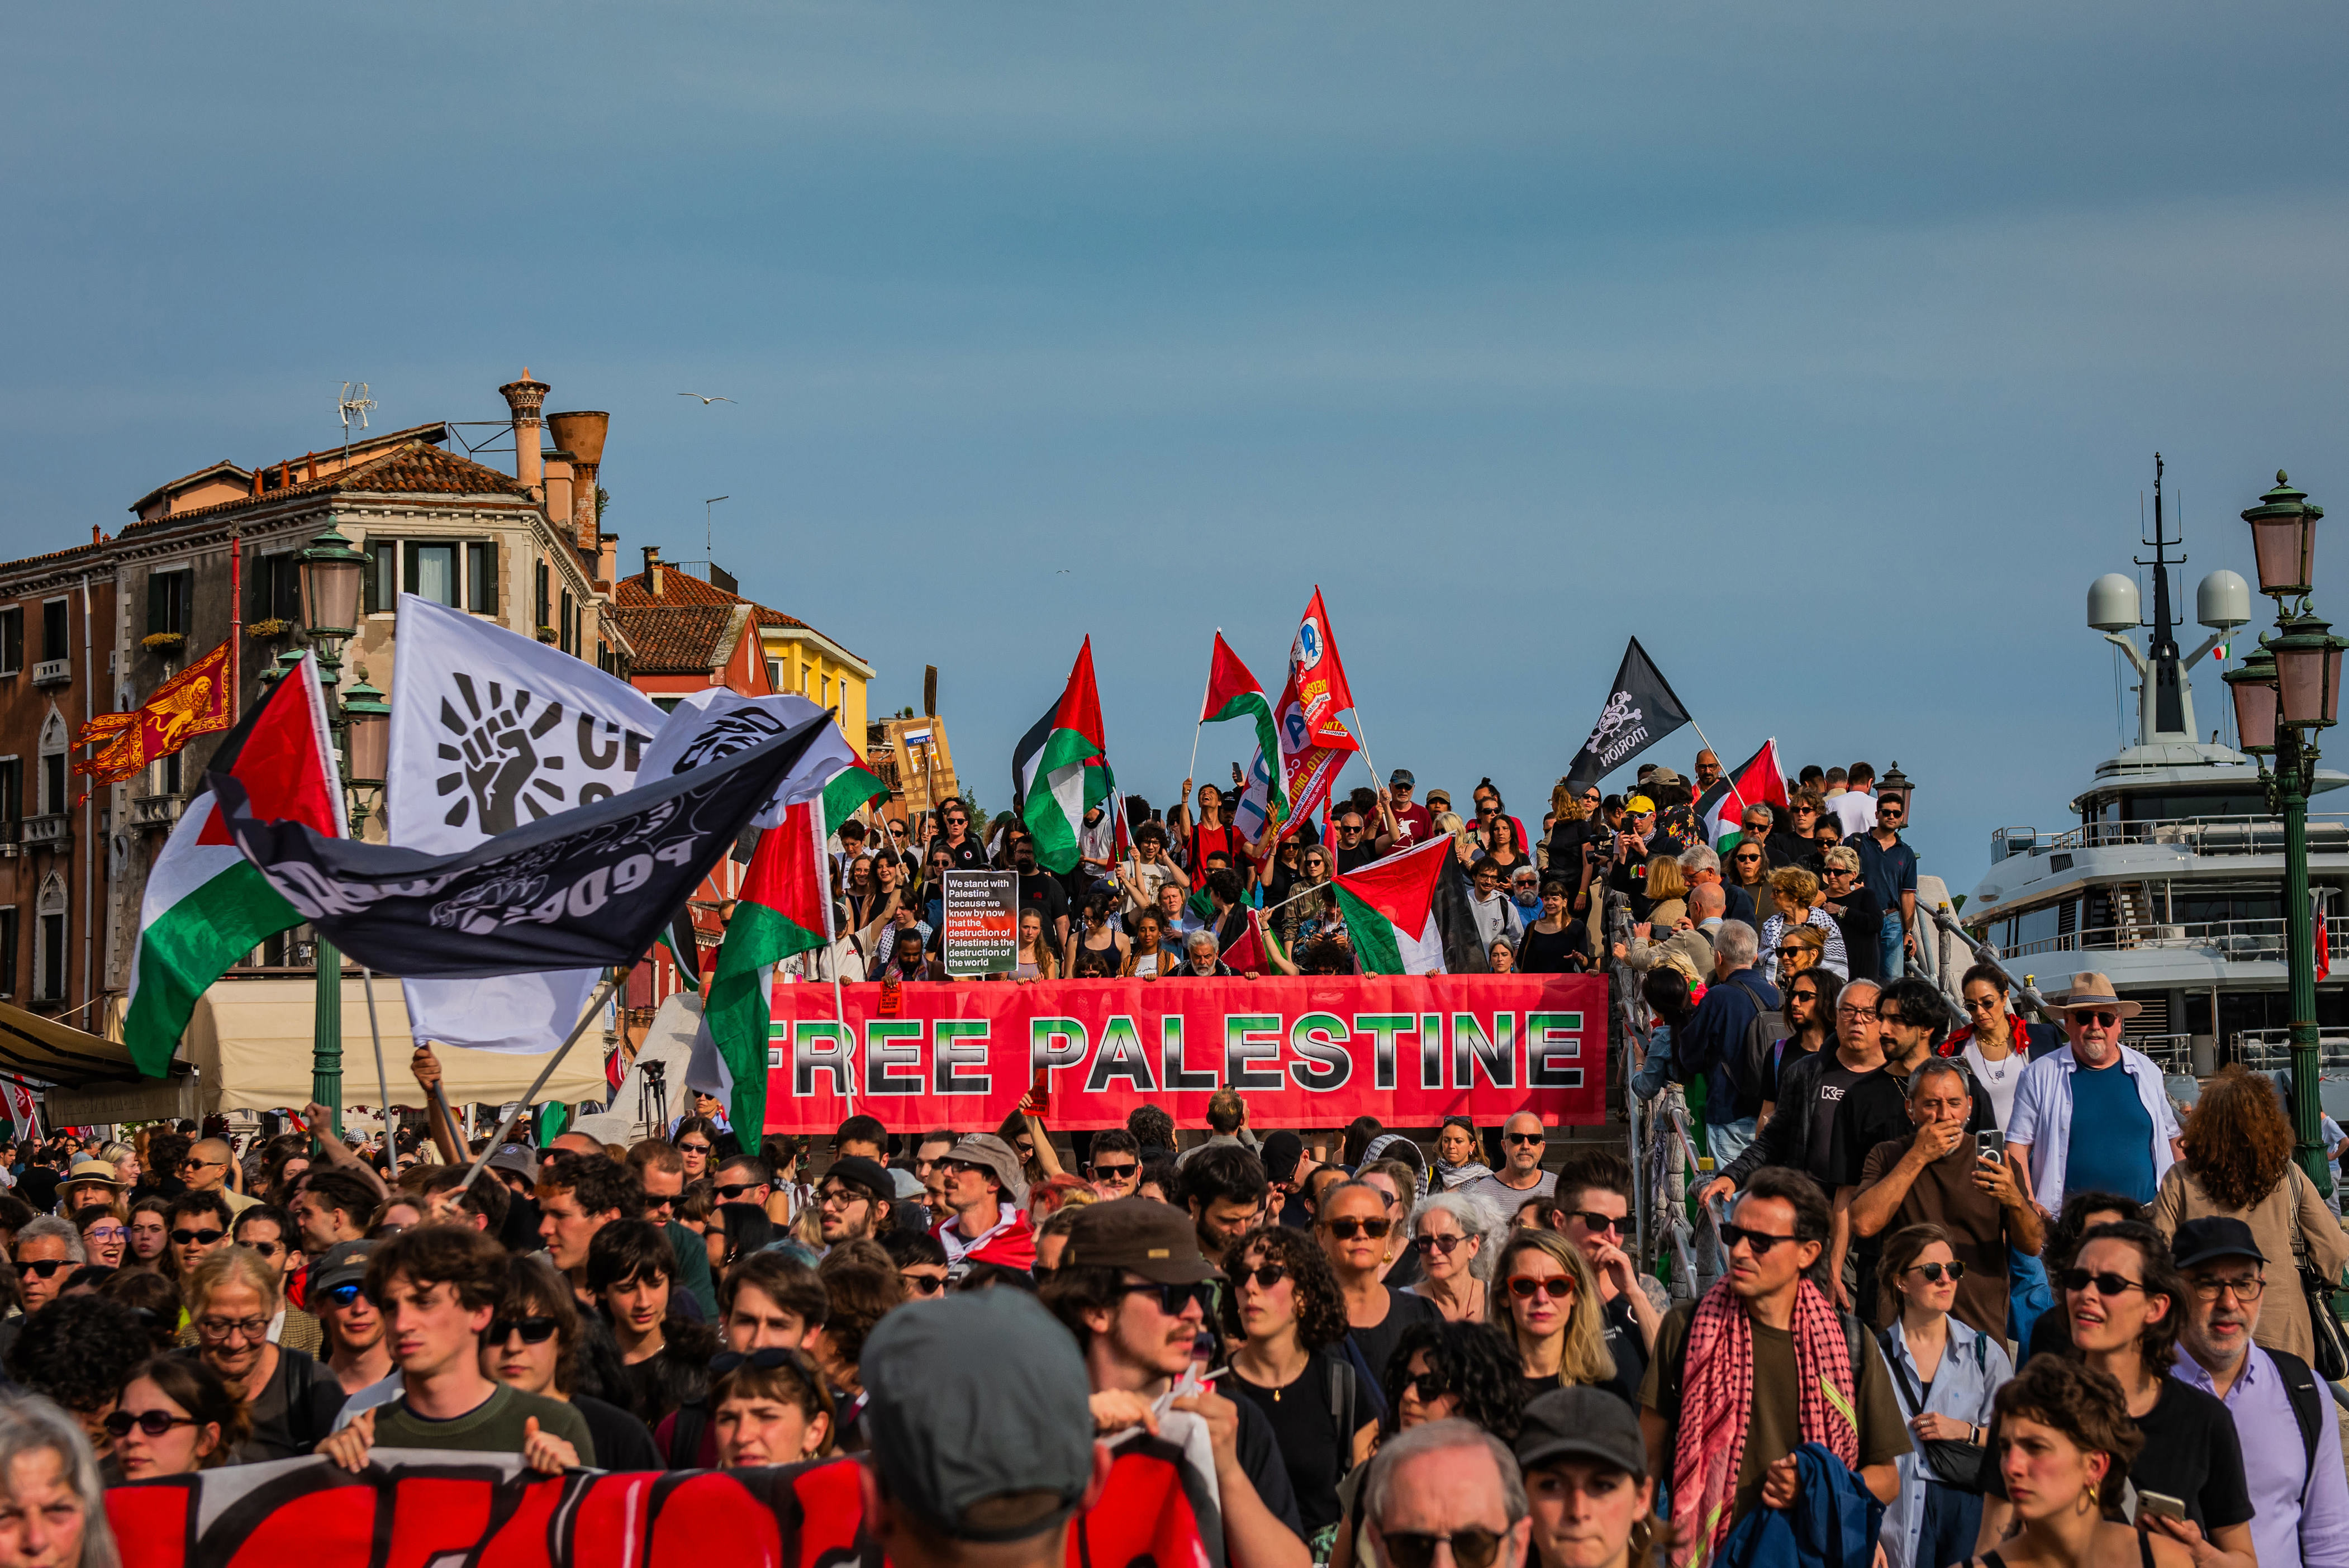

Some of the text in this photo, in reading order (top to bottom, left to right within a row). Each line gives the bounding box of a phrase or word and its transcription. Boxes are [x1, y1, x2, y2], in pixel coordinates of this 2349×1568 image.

[964, 880, 988, 888] stand
[990, 879, 1009, 887] with
[974, 909, 985, 918] by
[949, 928, 1010, 937] destruction of
[949, 938, 990, 947] Palestine
[949, 948, 1000, 957] destruction
[964, 958, 989, 967] world
[1030, 1011, 1584, 1094] PALESTINE
